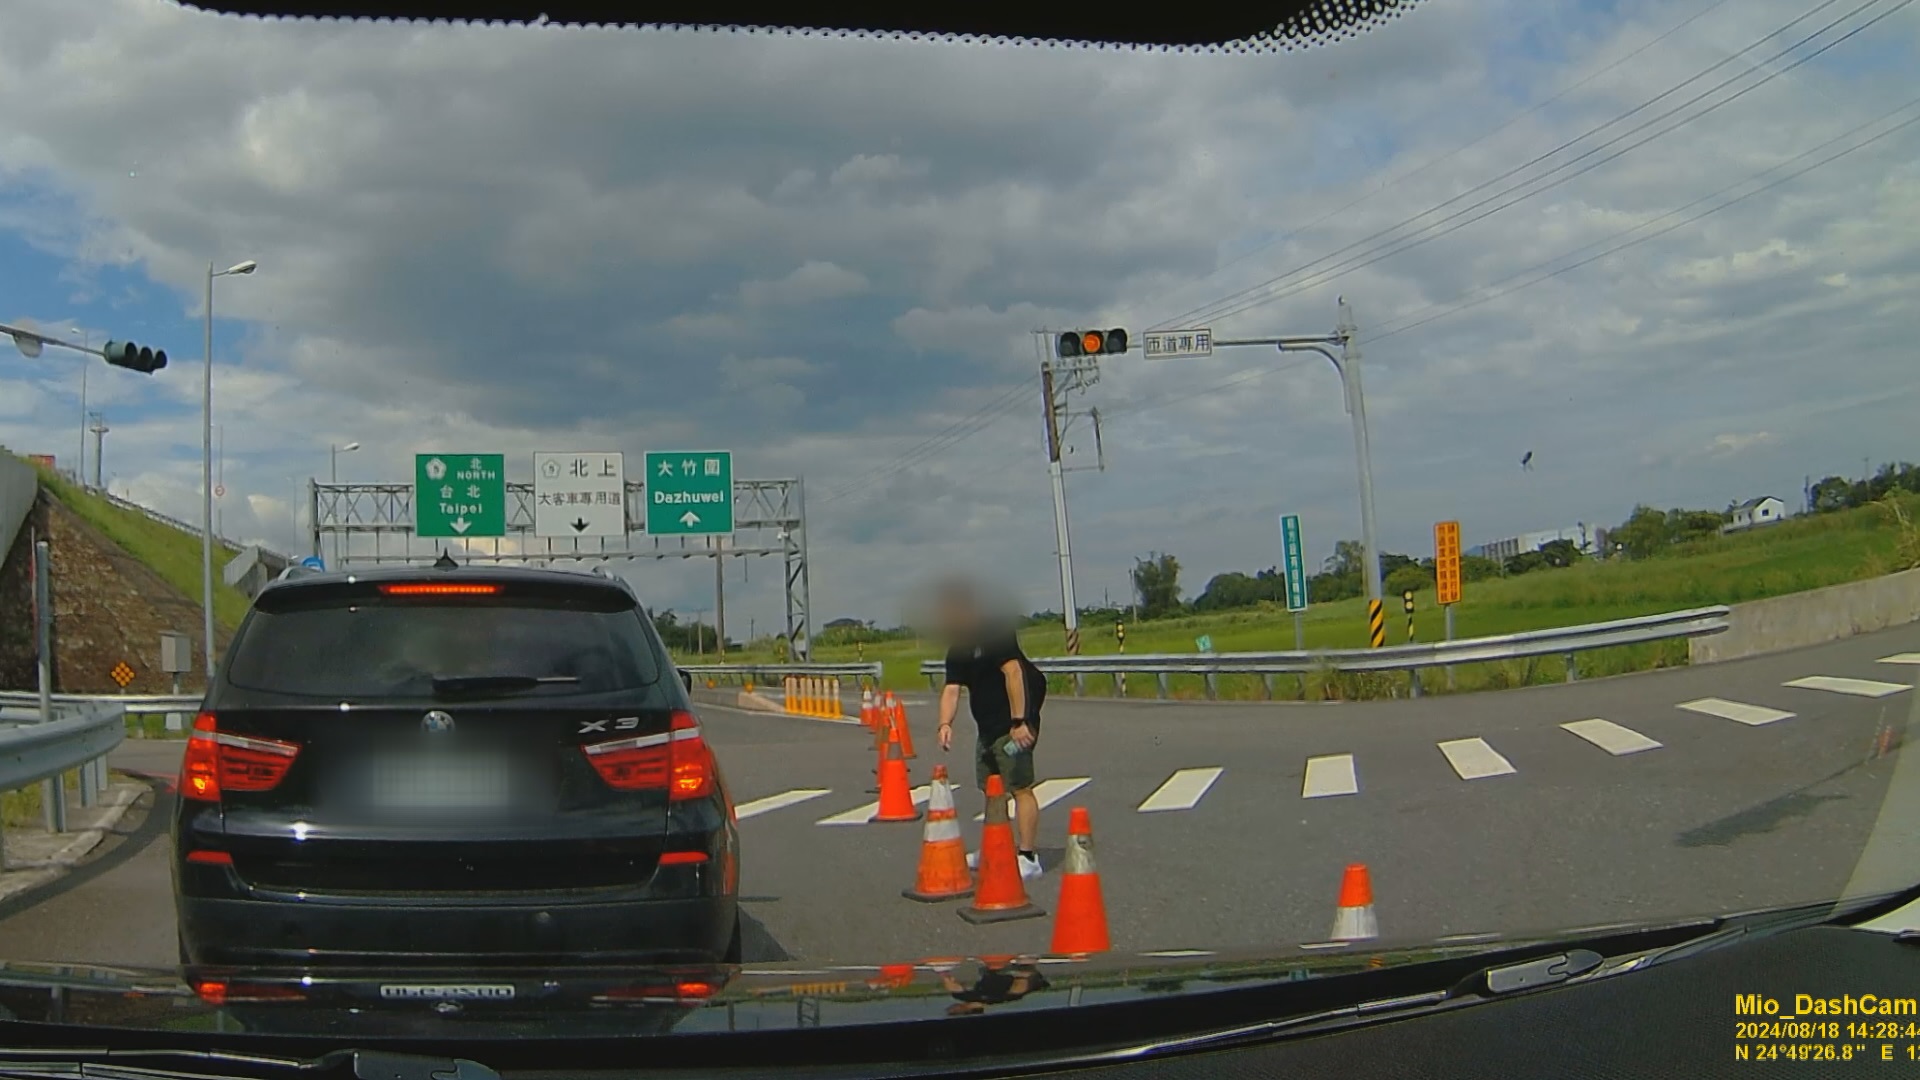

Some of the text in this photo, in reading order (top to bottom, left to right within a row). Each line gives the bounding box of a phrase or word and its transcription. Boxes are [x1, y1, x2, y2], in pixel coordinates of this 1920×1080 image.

[1146, 334, 1209, 354] 匝道專用
[470, 457, 482, 470] 北
[569, 458, 616, 477] 北上
[457, 470, 496, 480] NORTH
[440, 484, 481, 499] 台北
[537, 491, 621, 506] 大客車專用道
[654, 490, 725, 505] Dazhuwei
[439, 502, 482, 515] Taipei
[578, 716, 640, 734] X3
